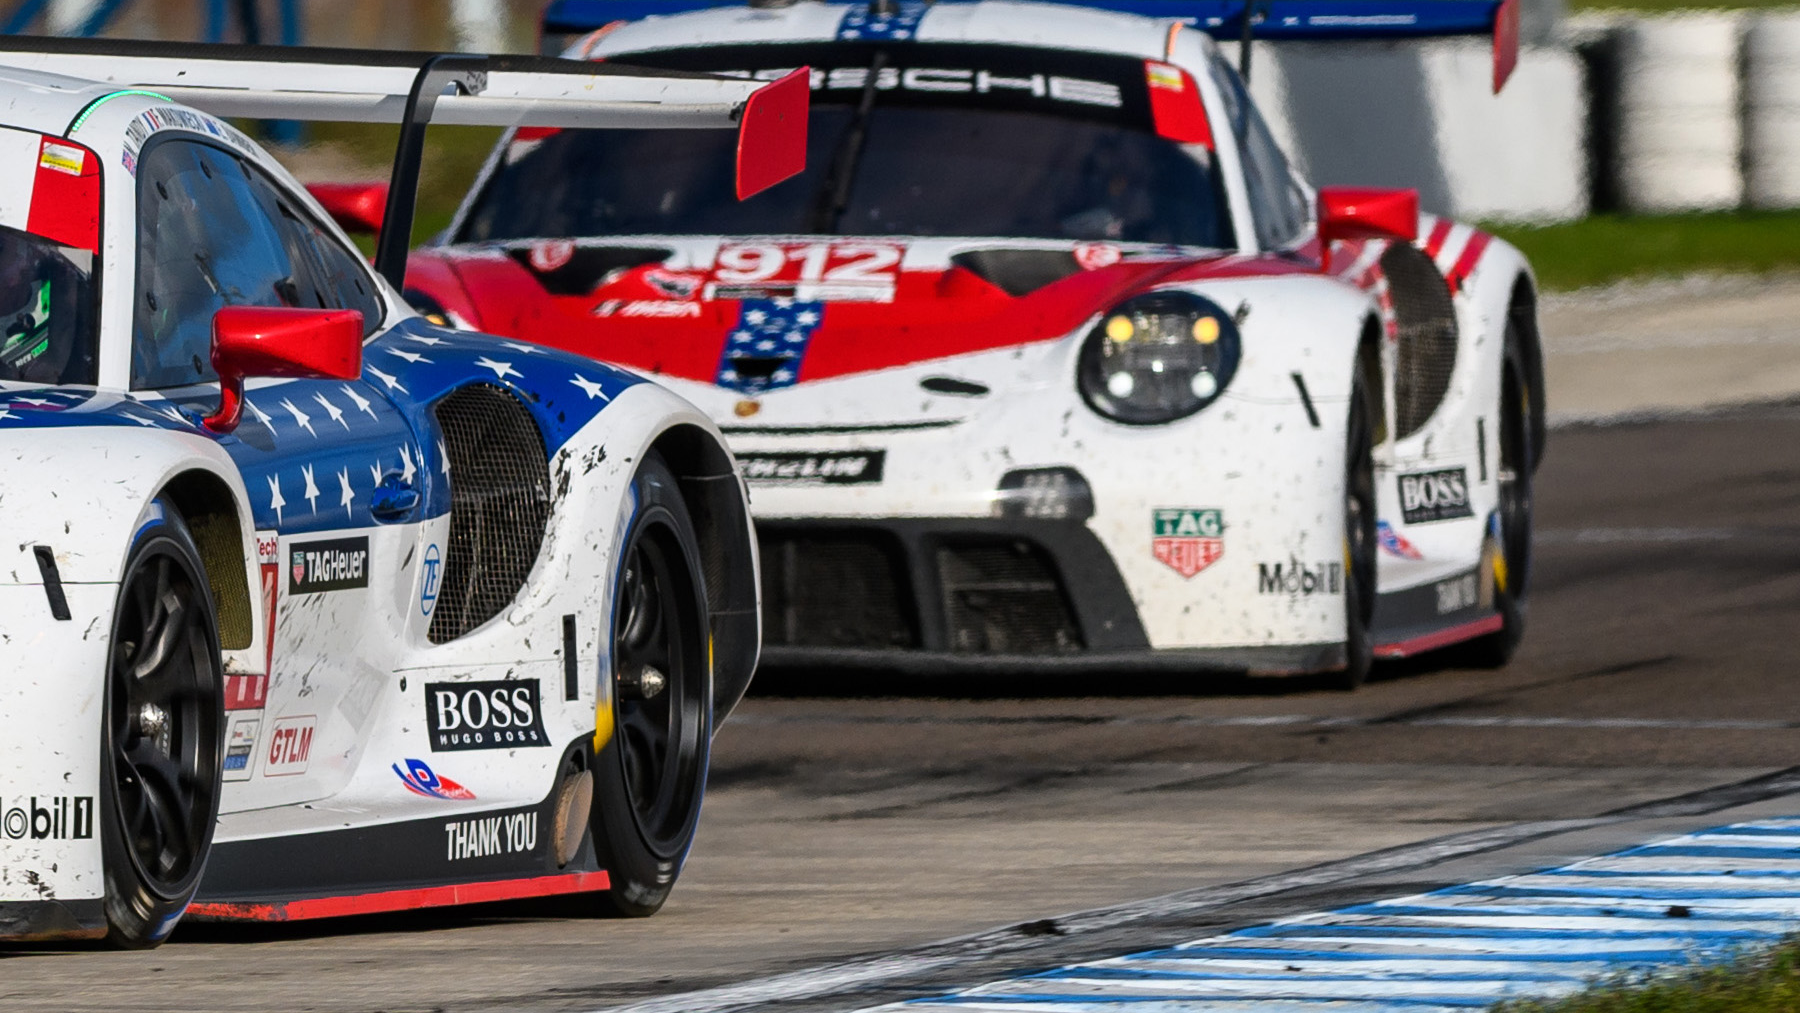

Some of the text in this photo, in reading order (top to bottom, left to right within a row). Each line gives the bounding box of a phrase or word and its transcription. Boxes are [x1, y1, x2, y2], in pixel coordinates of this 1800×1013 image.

[715, 242, 901, 282] 912
[1401, 471, 1466, 511] BOSS
[1157, 510, 1219, 535] TAG
[435, 688, 533, 730] BOSS
[269, 726, 314, 765] GTLM
[439, 730, 538, 746] HUGO BOSS
[445, 811, 538, 861] THANK YOU
